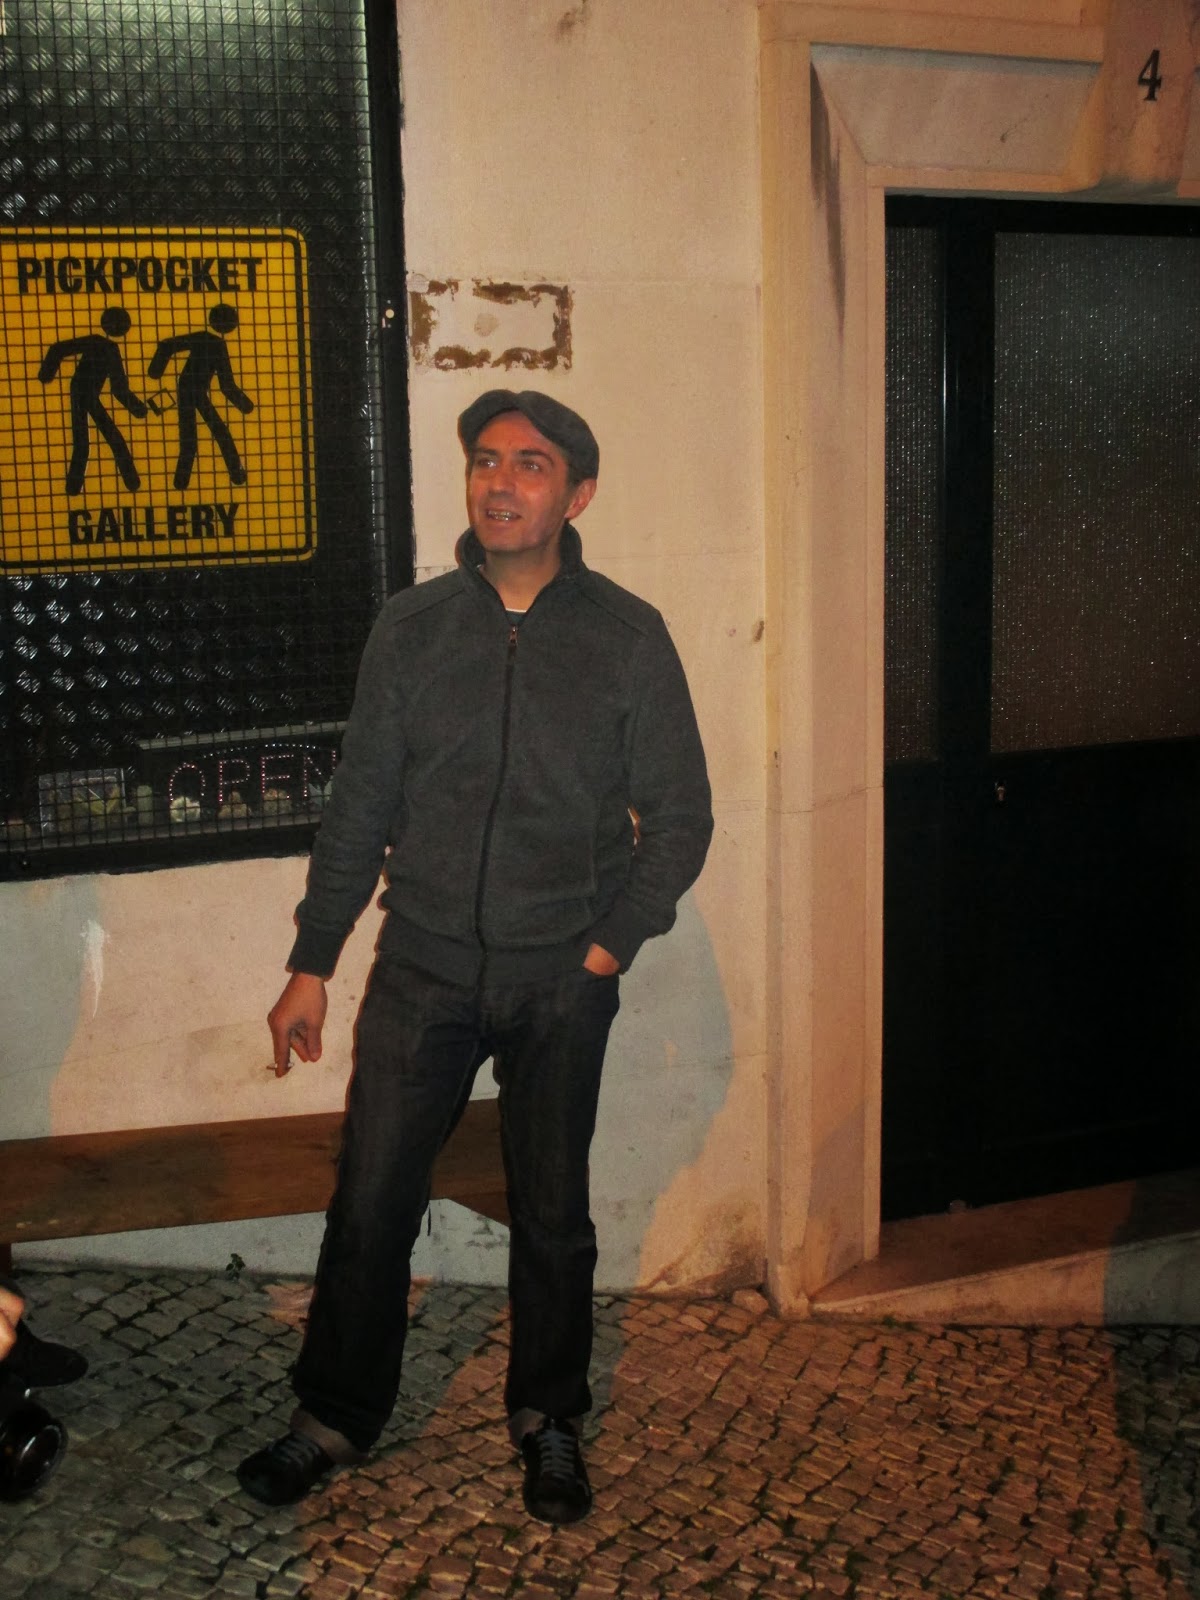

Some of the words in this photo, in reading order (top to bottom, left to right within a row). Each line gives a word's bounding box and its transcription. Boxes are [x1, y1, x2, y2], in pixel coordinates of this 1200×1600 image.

[1138, 49, 1162, 101] 4
[17, 255, 263, 295] PICKPOCKET
[69, 503, 240, 546] GALLERY
[168, 749, 338, 802] OPEN
